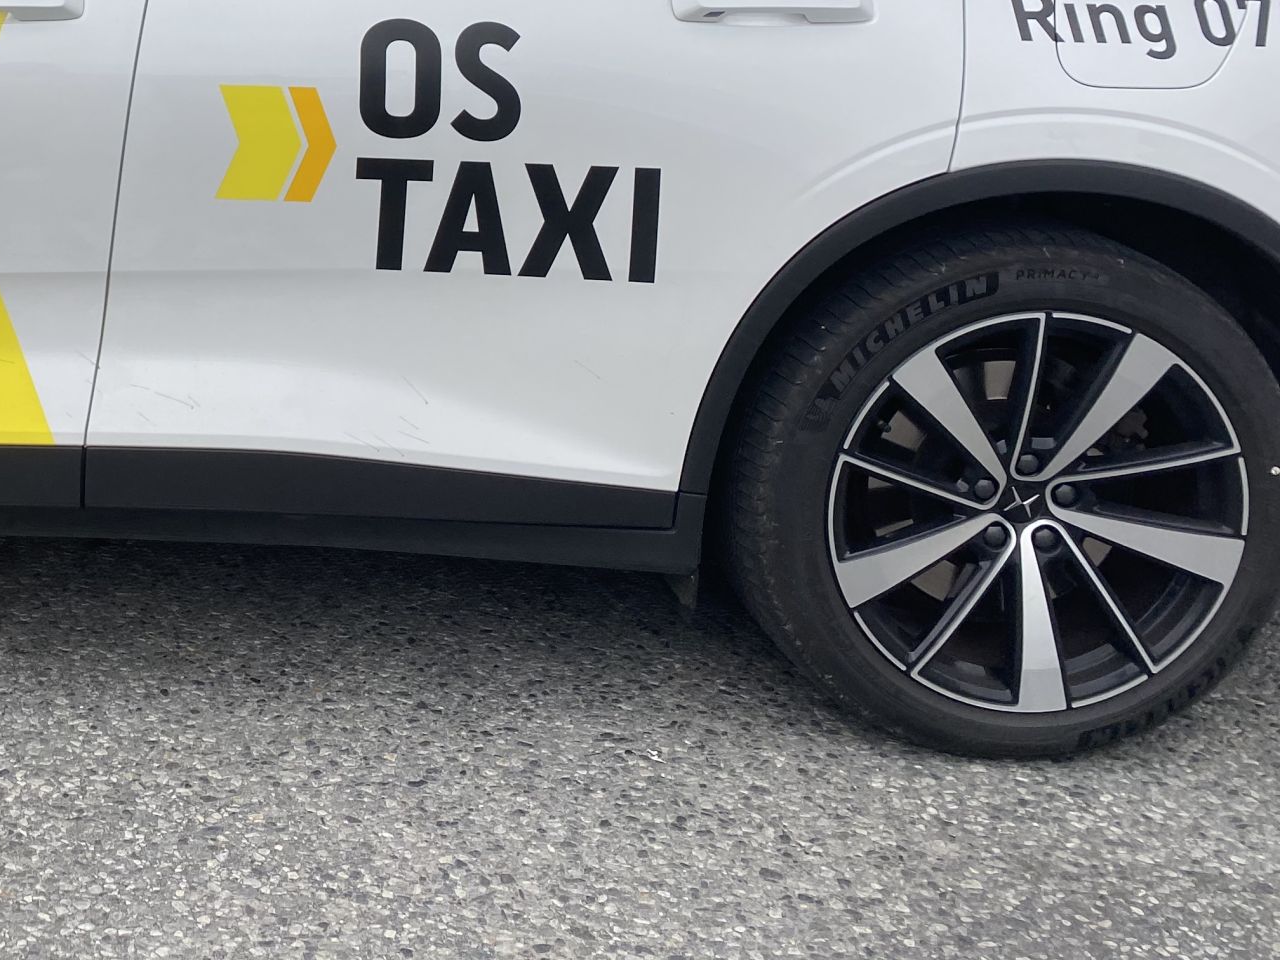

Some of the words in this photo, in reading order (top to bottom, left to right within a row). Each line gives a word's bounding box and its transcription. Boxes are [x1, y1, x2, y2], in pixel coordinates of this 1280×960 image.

[359, 18, 522, 142] OS
[355, 157, 662, 284] TAXI
[829, 274, 988, 393] MICHELIN
